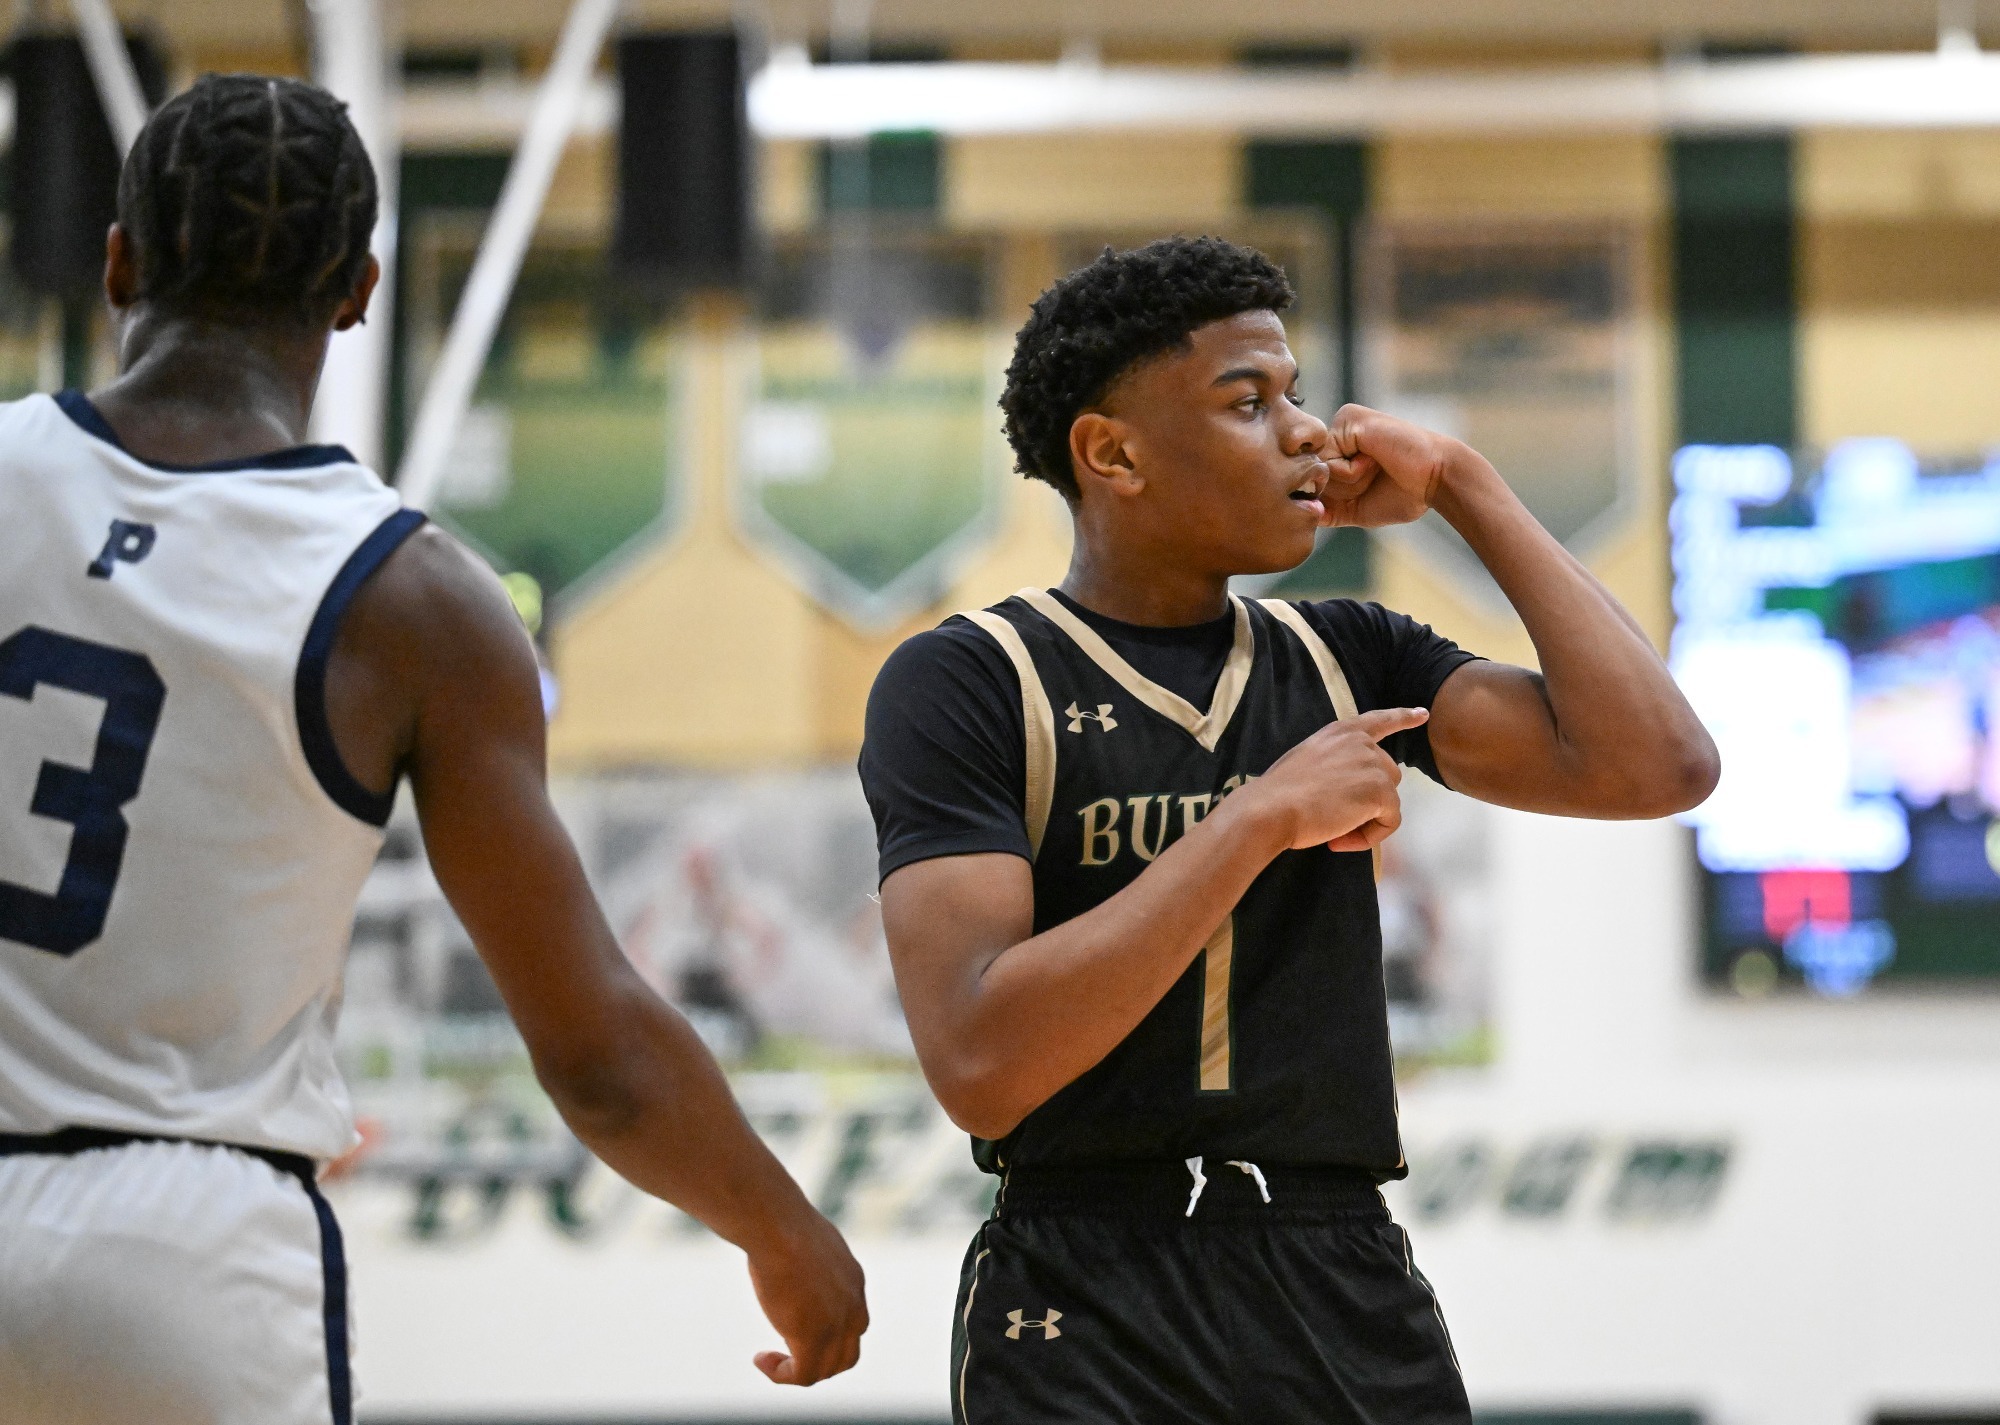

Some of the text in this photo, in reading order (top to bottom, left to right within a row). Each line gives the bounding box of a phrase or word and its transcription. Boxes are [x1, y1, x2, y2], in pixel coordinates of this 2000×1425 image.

[87, 518, 158, 580] P
[0, 624, 168, 958] 3
[1198, 911, 1235, 1093] 1
